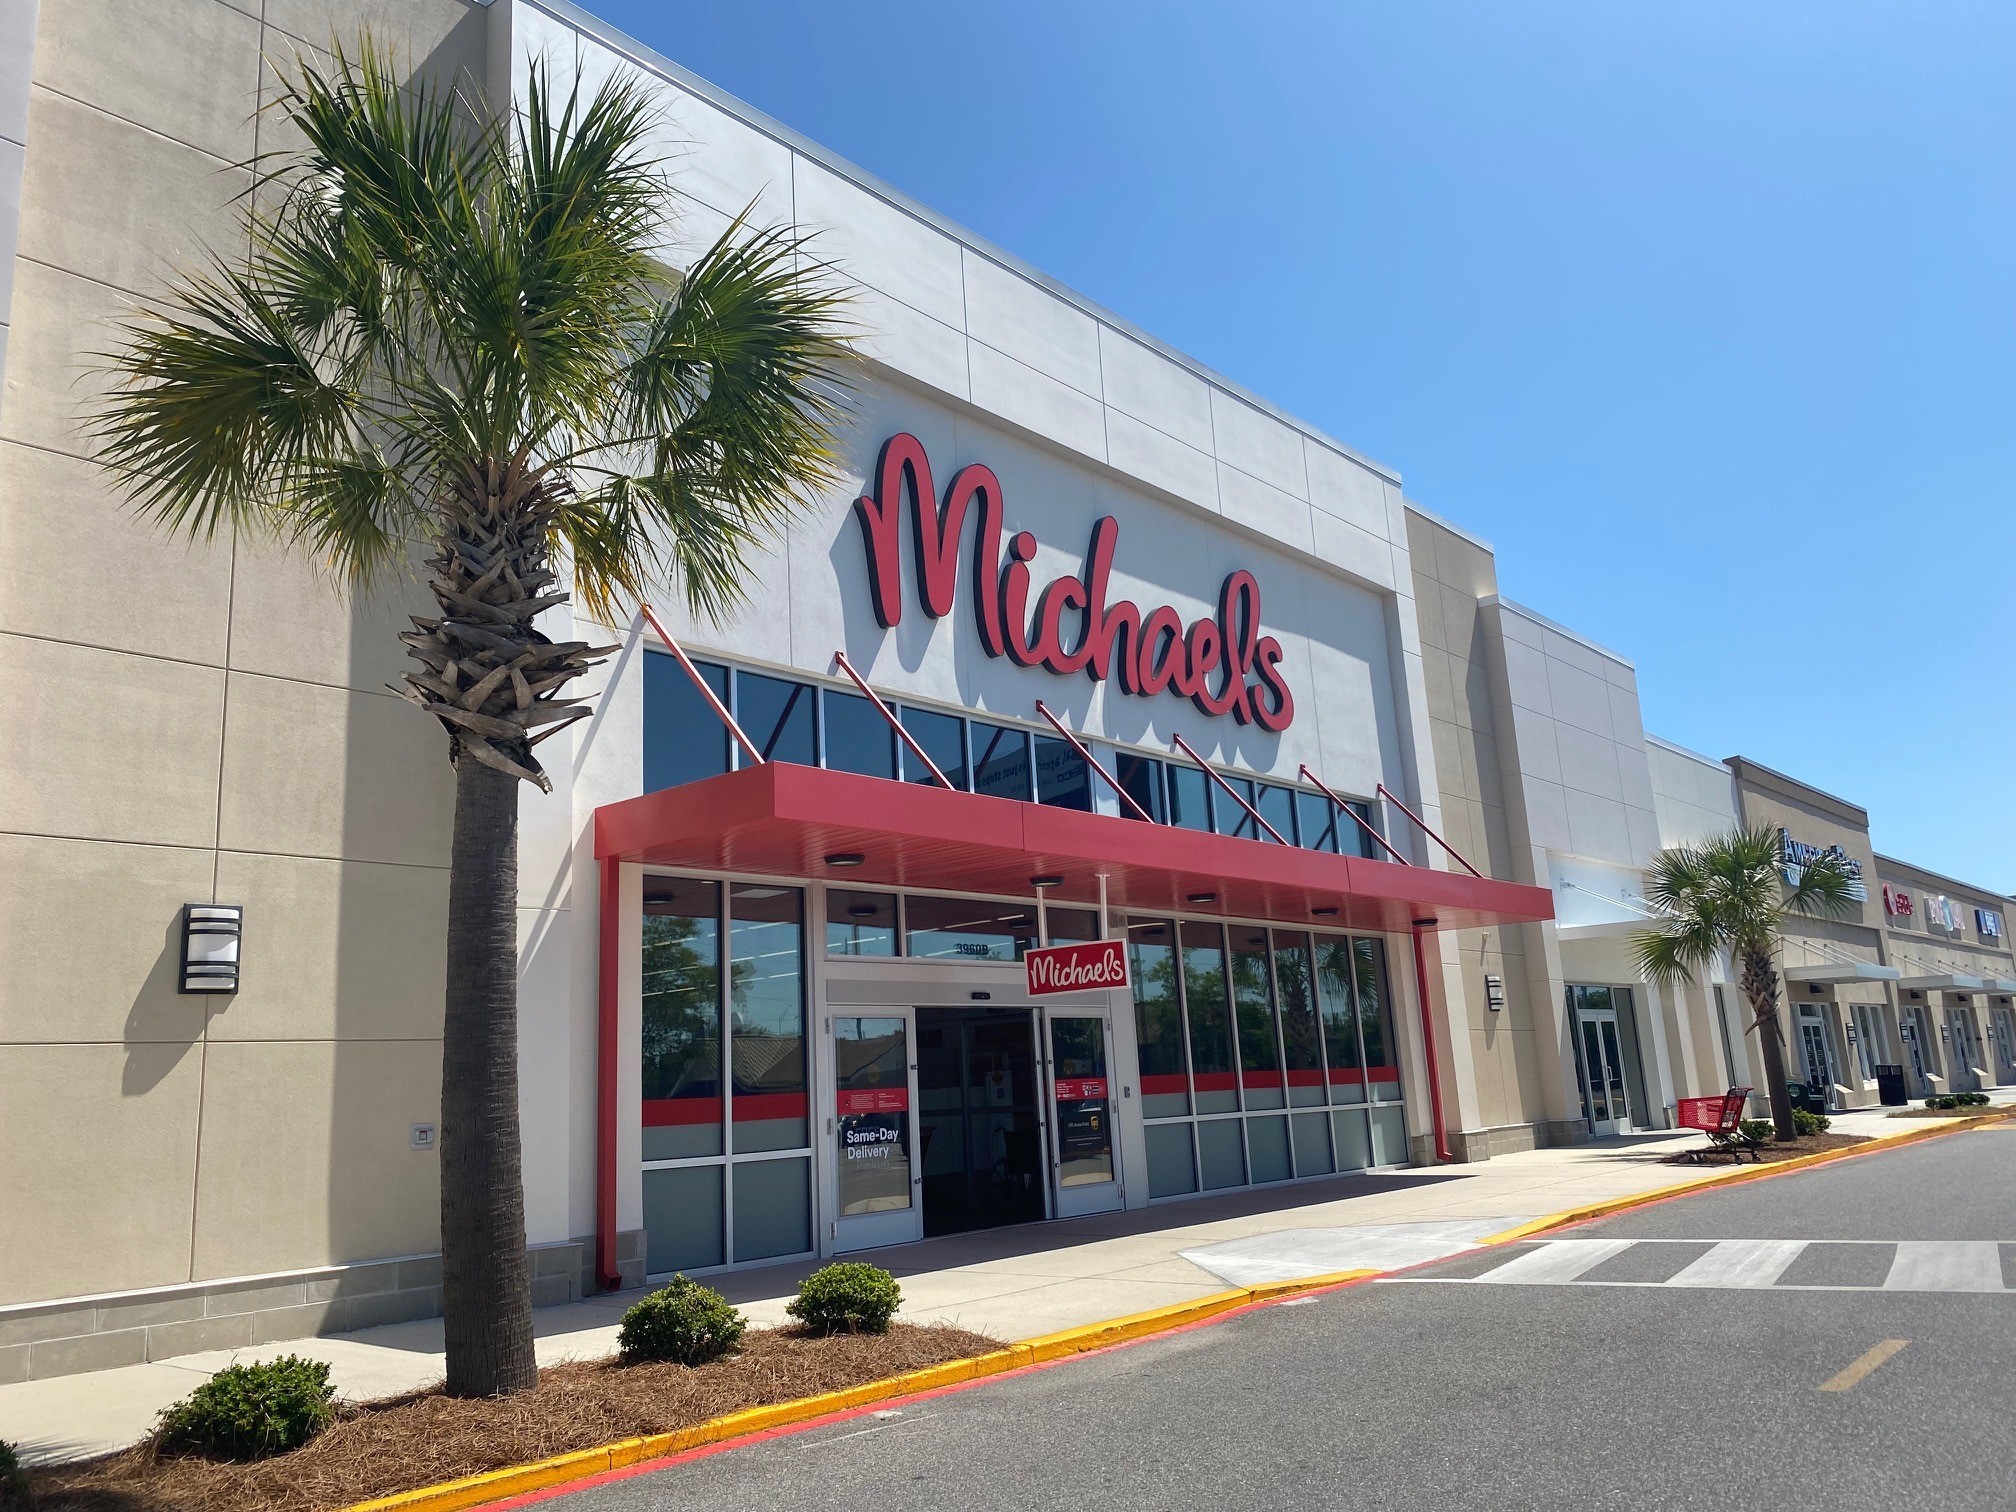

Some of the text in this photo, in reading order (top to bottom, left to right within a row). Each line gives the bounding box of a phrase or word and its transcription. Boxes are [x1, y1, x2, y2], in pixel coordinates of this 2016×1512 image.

[854, 432, 1294, 732] Michaels
[955, 943, 989, 955] 3960B
[1030, 948, 1124, 989] Michaels
[847, 1127, 899, 1144] Same-Day
[847, 1145, 890, 1160] Delivery
